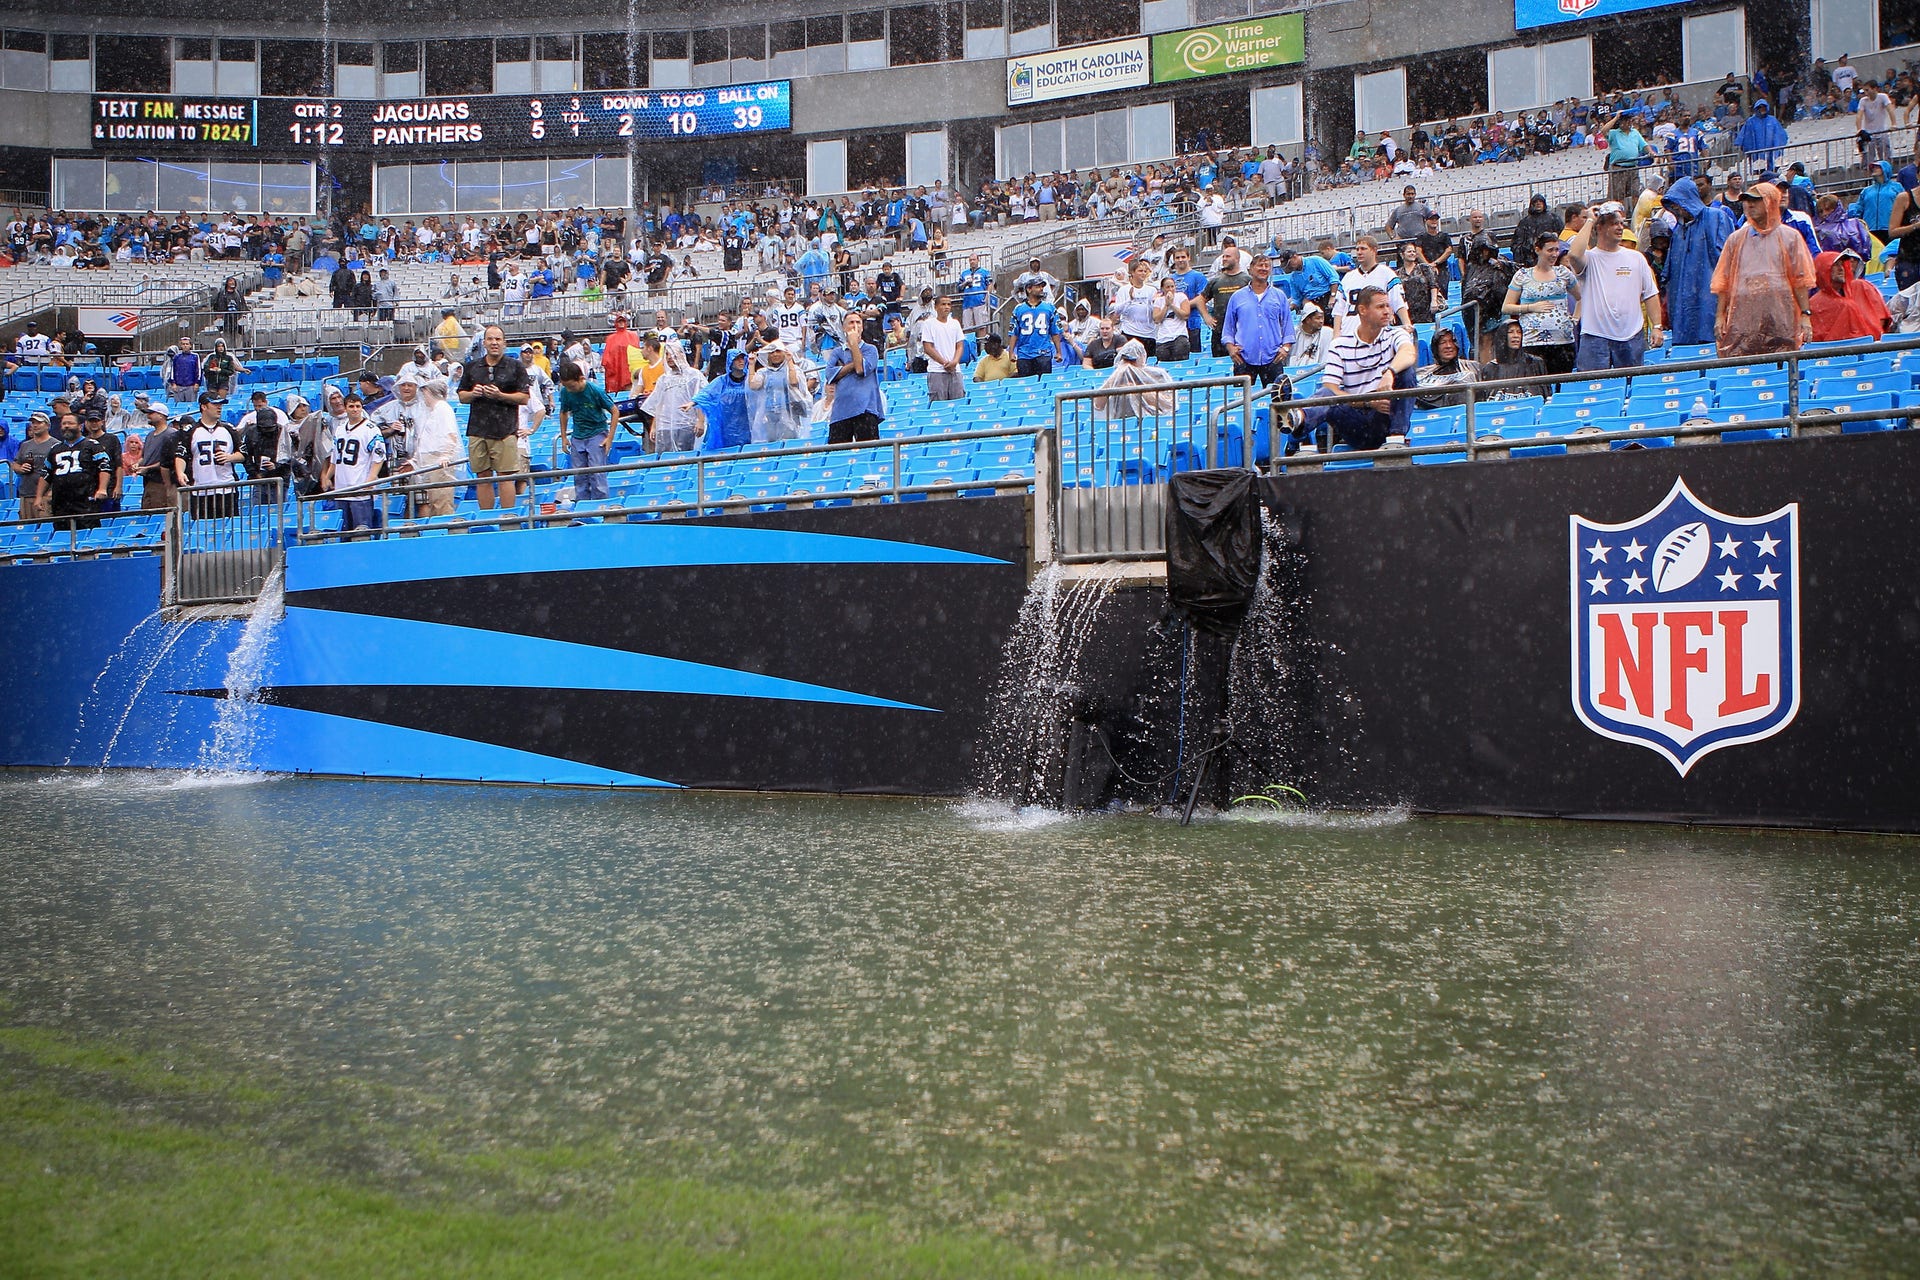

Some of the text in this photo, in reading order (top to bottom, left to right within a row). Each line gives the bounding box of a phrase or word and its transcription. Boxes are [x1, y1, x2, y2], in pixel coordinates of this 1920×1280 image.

[1225, 25, 1264, 40] Time
[1225, 36, 1282, 54] Warner
[1036, 49, 1143, 78] NORTH CAROLINA
[1225, 51, 1270, 69] Cable
[1036, 70, 1096, 88] EDUCATION
[1099, 62, 1144, 79] LOTTERY
[603, 96, 649, 111] DOWN
[660, 94, 705, 108] TO GO
[718, 86, 778, 104] BALL ON
[100, 101, 138, 118] TEXT
[184, 105, 246, 120] MESSAGE
[294, 104, 342, 118] QTR 2
[373, 103, 470, 123] JAGUARS
[530, 100, 543, 119] 3
[571, 98, 580, 111] 3
[618, 115, 633, 137] 2
[668, 112, 697, 134] 10
[733, 106, 763, 129] 39
[95, 124, 251, 141] & LOCATION TO 78247
[289, 123, 344, 145] 1:12
[373, 125, 483, 145] PANTHERS
[531, 120, 545, 139] 5
[571, 124, 579, 137] 1
[1678, 136, 1695, 153] 21
[868, 206, 873, 216] 1
[891, 205, 897, 217] 1
[915, 202, 920, 210] 1
[727, 238, 738, 248] 34
[780, 313, 798, 328] 89
[1020, 312, 1048, 336] 34
[55, 450, 83, 476] 51
[1597, 610, 1771, 732] NFL
